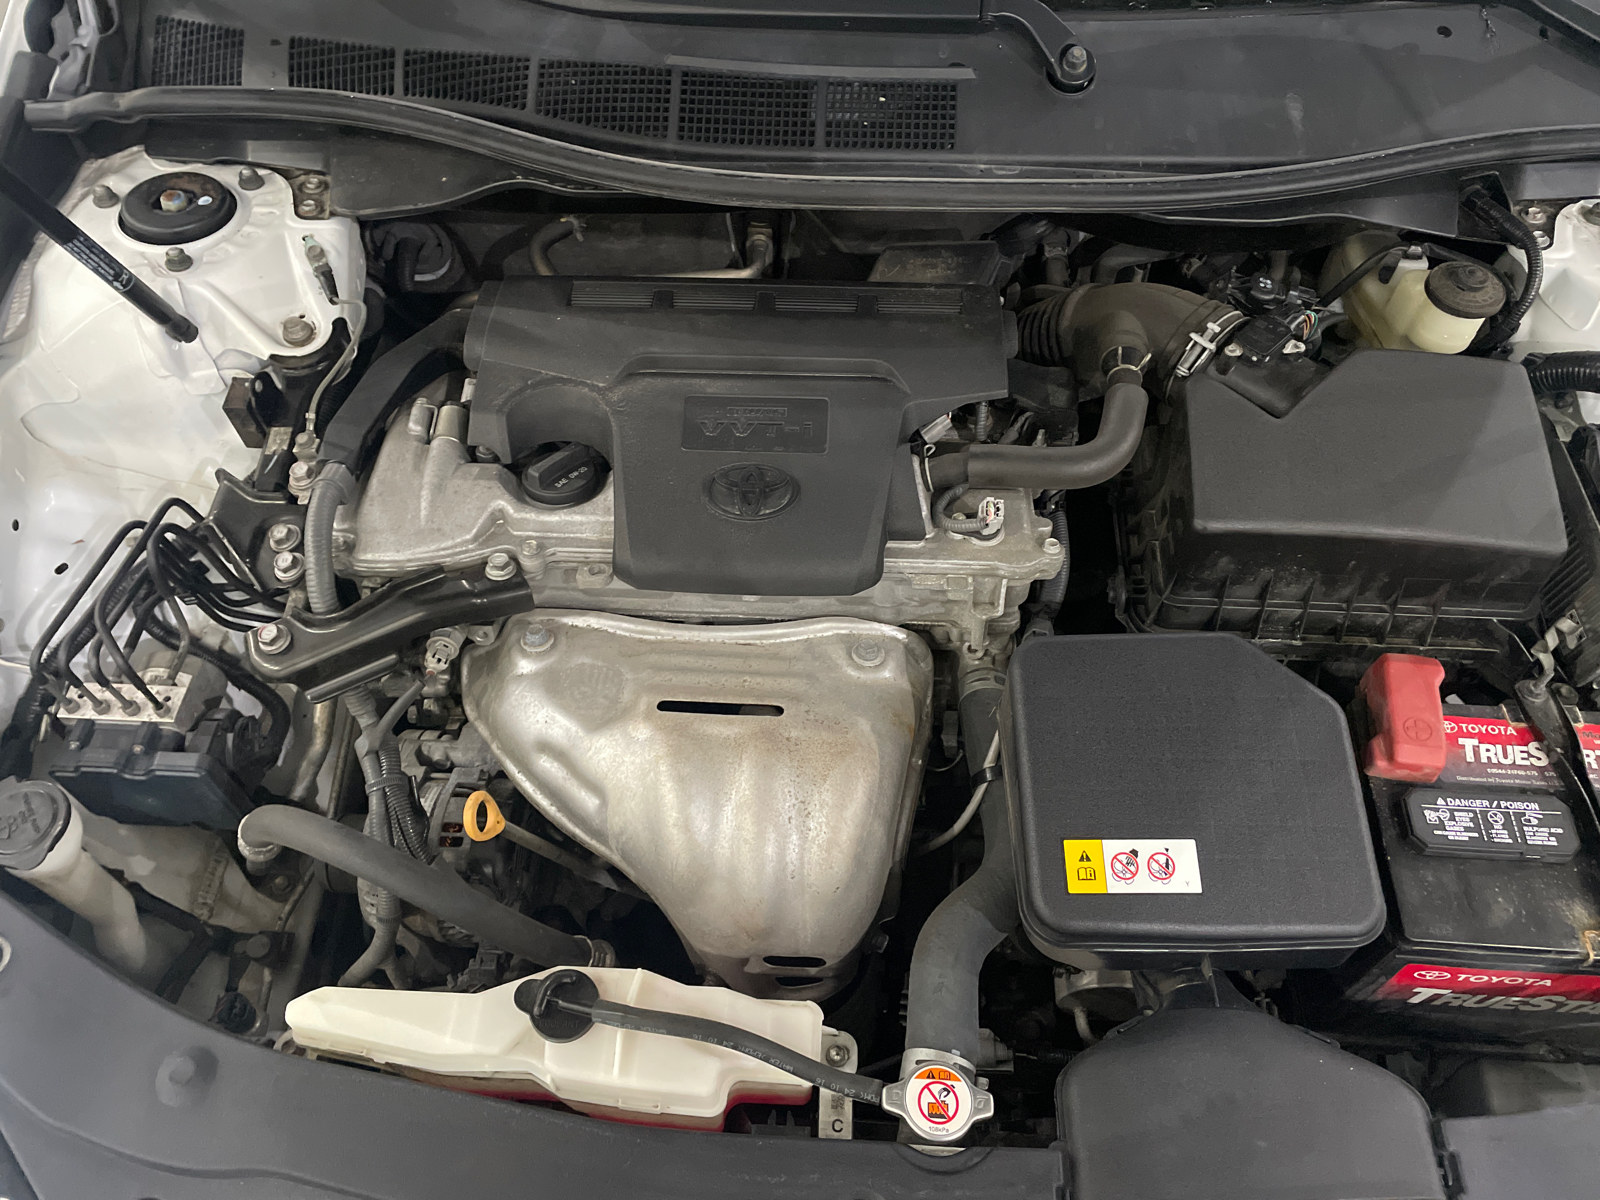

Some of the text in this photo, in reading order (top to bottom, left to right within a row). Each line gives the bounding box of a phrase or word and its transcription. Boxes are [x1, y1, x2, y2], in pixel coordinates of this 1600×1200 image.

[119, 269, 130, 284] R
[697, 420, 813, 437] VVT-i
[554, 466, 588, 488] SAE 0W-20
[1459, 723, 1517, 736] TOYOTA
[1446, 797, 1490, 808] DANGER
[1500, 800, 1540, 811] POISON
[1457, 973, 1552, 987] TOYOTA
[538, 1018, 579, 1028] COOLANT
[768, 1058, 794, 1073] WATER
[830, 1083, 840, 1091] 10
[844, 1088, 856, 1097] 24
[831, 1118, 844, 1133] C
